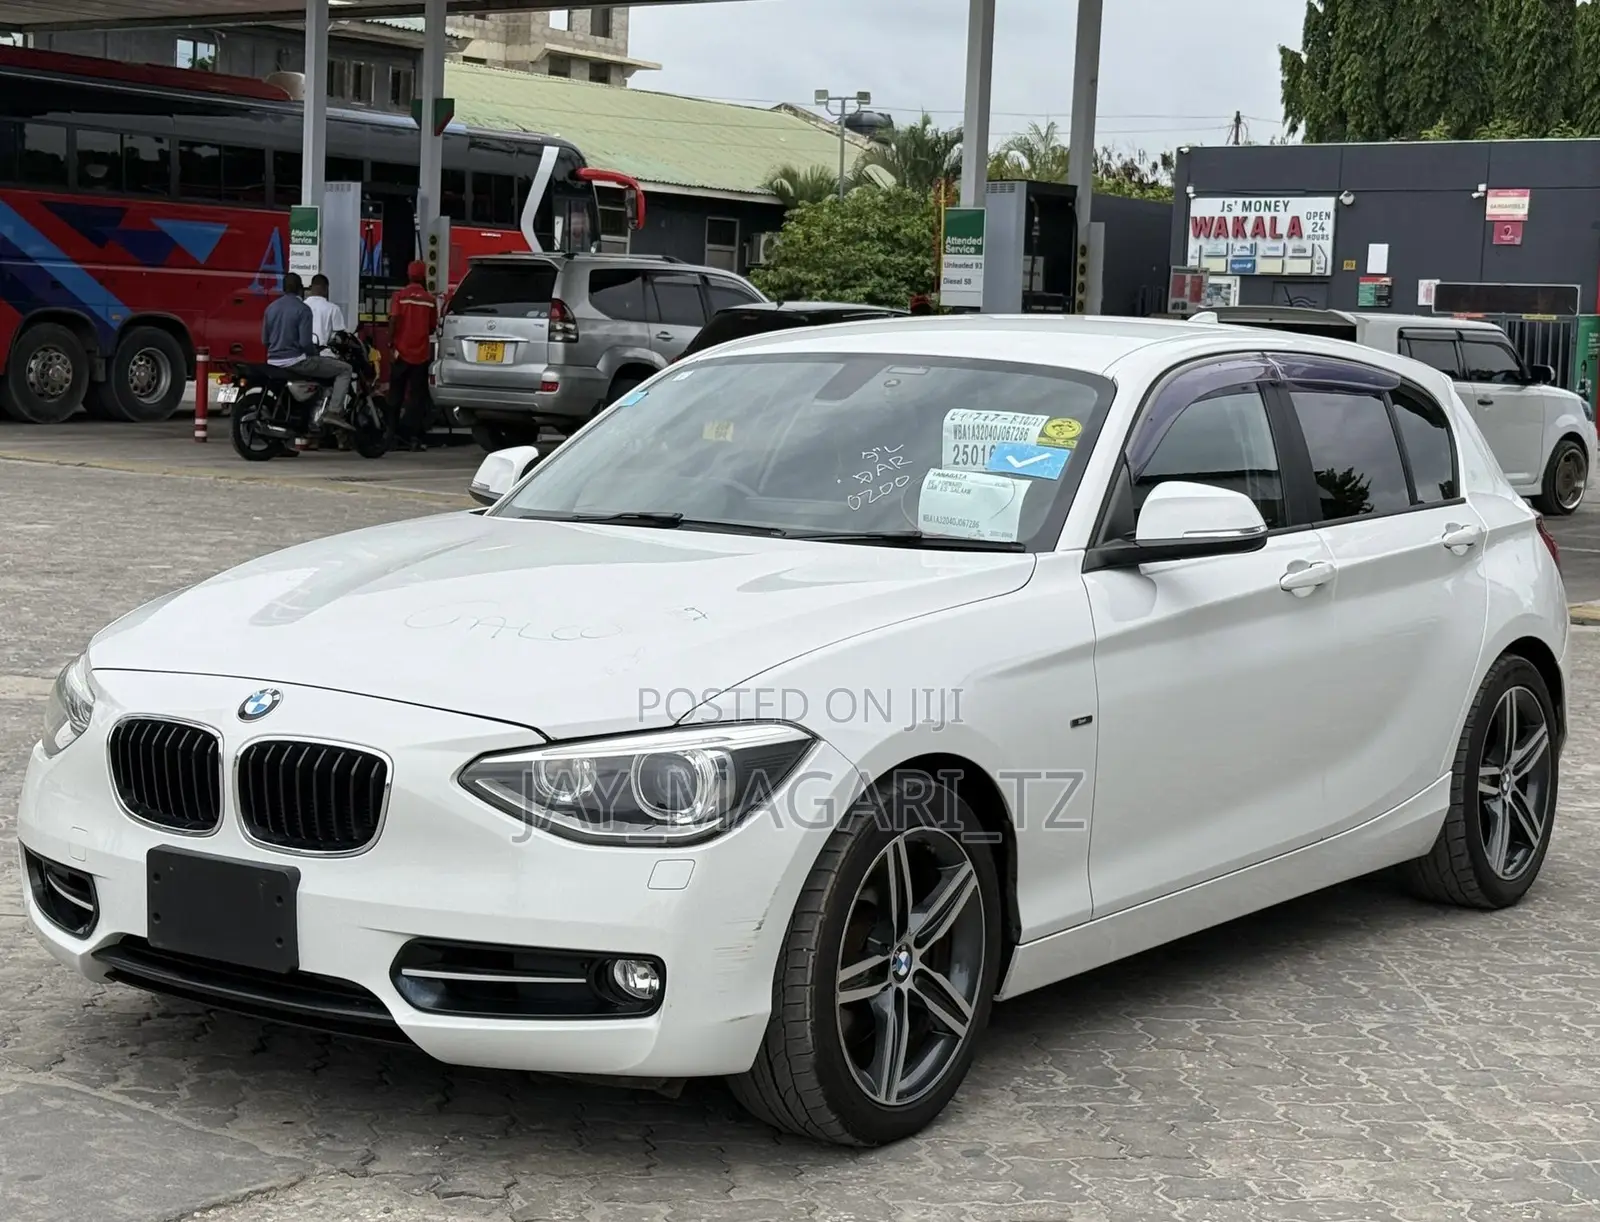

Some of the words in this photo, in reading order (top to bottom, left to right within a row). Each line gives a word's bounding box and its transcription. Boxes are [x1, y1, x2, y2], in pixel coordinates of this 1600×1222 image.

[1220, 201, 1238, 212] Js'
[1241, 200, 1290, 213] MONEY
[1305, 211, 1331, 221] OPEN
[1191, 215, 1303, 240] WAKALA
[1311, 221, 1325, 233] 24
[291, 229, 317, 237] Attended
[1306, 233, 1330, 241] HOURS
[945, 236, 982, 245] Attended
[946, 245, 975, 254] Service
[943, 277, 963, 285] Diesel
